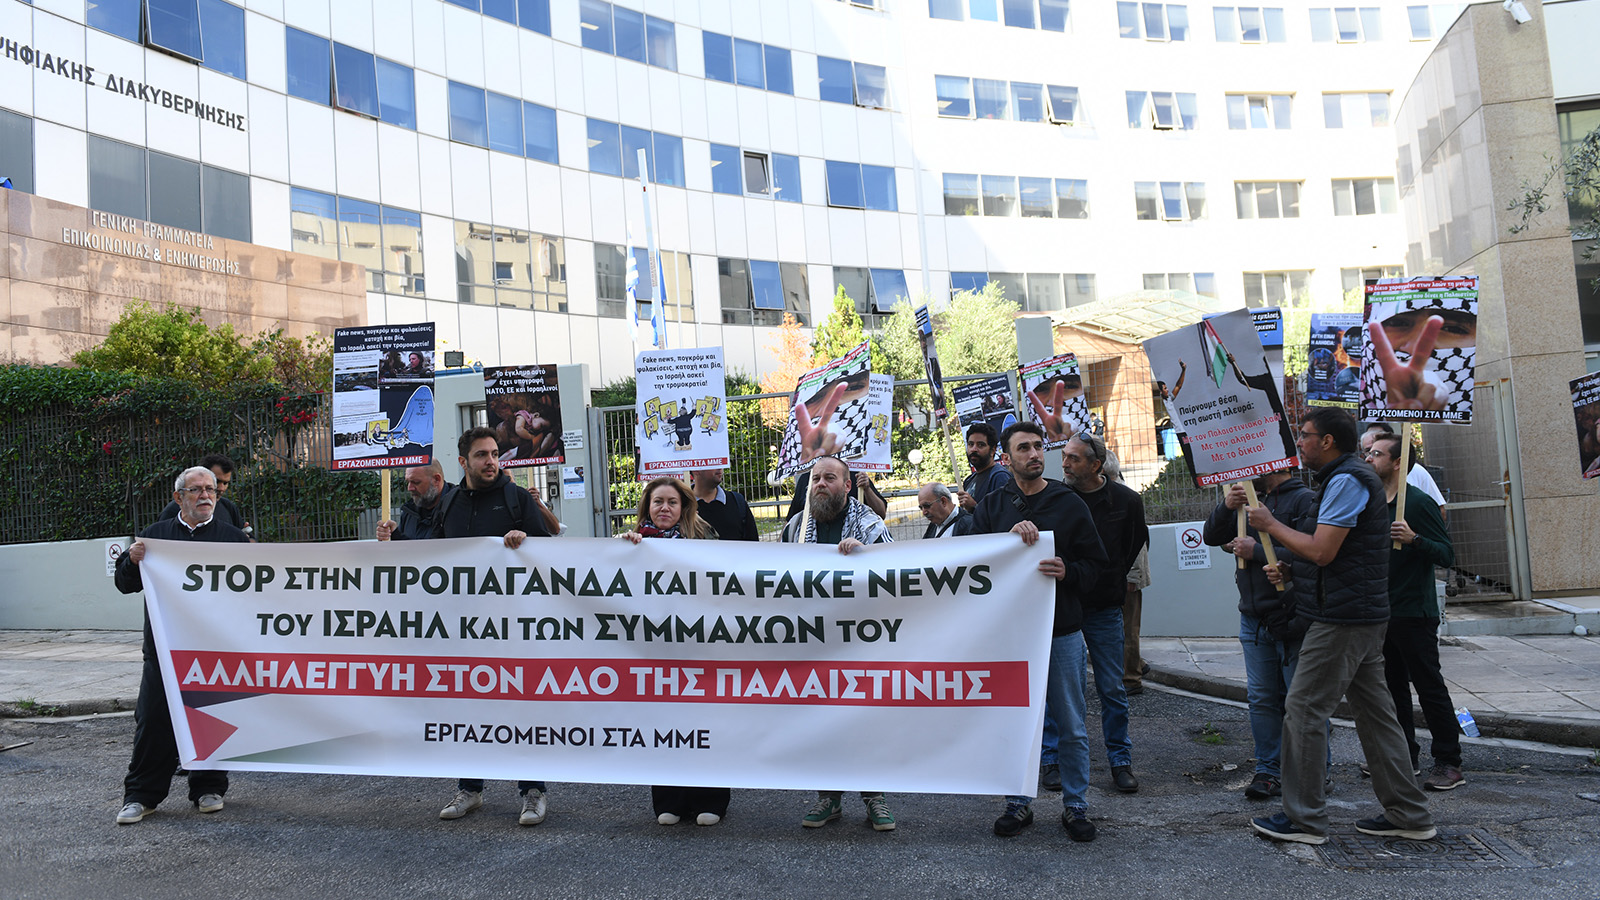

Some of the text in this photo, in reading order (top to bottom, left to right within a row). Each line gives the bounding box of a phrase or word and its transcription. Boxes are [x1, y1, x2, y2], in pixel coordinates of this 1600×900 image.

[105, 74, 246, 132] ΔΙΑΚΥΒΕΡΝΗΣΗΣ
[92, 210, 214, 250] ΓΕΝΙΚΗ ΓΡΑΜΜΑΤΕΙΑ
[62, 227, 240, 275] ΕΠΙΚΟΙΝΩΝΙΑΣ & ΕΝΗΜΕΡΩΣΗΣ
[636, 365, 674, 374] φυλακίσεις,
[676, 363, 698, 371] κατοχή
[710, 362, 722, 370] βία,
[677, 354, 704, 362] πογκρόμ
[664, 372, 686, 381] Ισραήλ
[666, 380, 708, 390] τρομοκρατία!
[1178, 394, 1238, 416] Παίρνουμε θέση
[1183, 401, 1255, 427] στη σωστή πλευρά:
[1368, 409, 1463, 420] ΕΡΓΑΖΟΜΕΝΟΙ ΣΤΑ ΜΜΕ
[1182, 436, 1194, 445] Με
[1195, 432, 1206, 441] τον
[1207, 418, 1262, 438] Παλαιστινιακό
[1201, 428, 1268, 452] Με την αλήθεια!
[338, 456, 422, 468] ΕΡΓΑΖΟΜΕΝΟΙ ΣΤΑ ΜΜΕ
[498, 458, 535, 467] ΡΓΑΖΟΜΕΝΟΙ
[1210, 442, 1266, 462] Με το δίκιο!
[648, 460, 693, 470] ΕΡΓΑΖΟΜΕΝΟΙ
[1202, 458, 1294, 485] ΕΡΓΑΖΟΜΕΝΟΙ ΣΤΑ ΜΜΕ
[182, 564, 994, 599] STOP ΣΤΗΝ ΠΡΟΠΑΓΑΝΔΑ ΚΑΙ ΤΑ FAKE NEWS
[256, 610, 904, 644] ΤΟΥ ΙΣΡΑΗΛ ΚΑΙ ΤΩΝ ΣΥΜΜΑΧΩΝ ΤΟΥ
[182, 657, 992, 700] ΑΛΛΗΛΕΓΓΥΗ ΣΤΟΝ ΛΑΟ ΤΗΣ ΠΑΛΑΙΣΤΙΝΗΣ
[424, 723, 711, 750] ΕΡΓΑΖΟΜΕΝΟΙ ΣΤΑ ΜΜΕ
